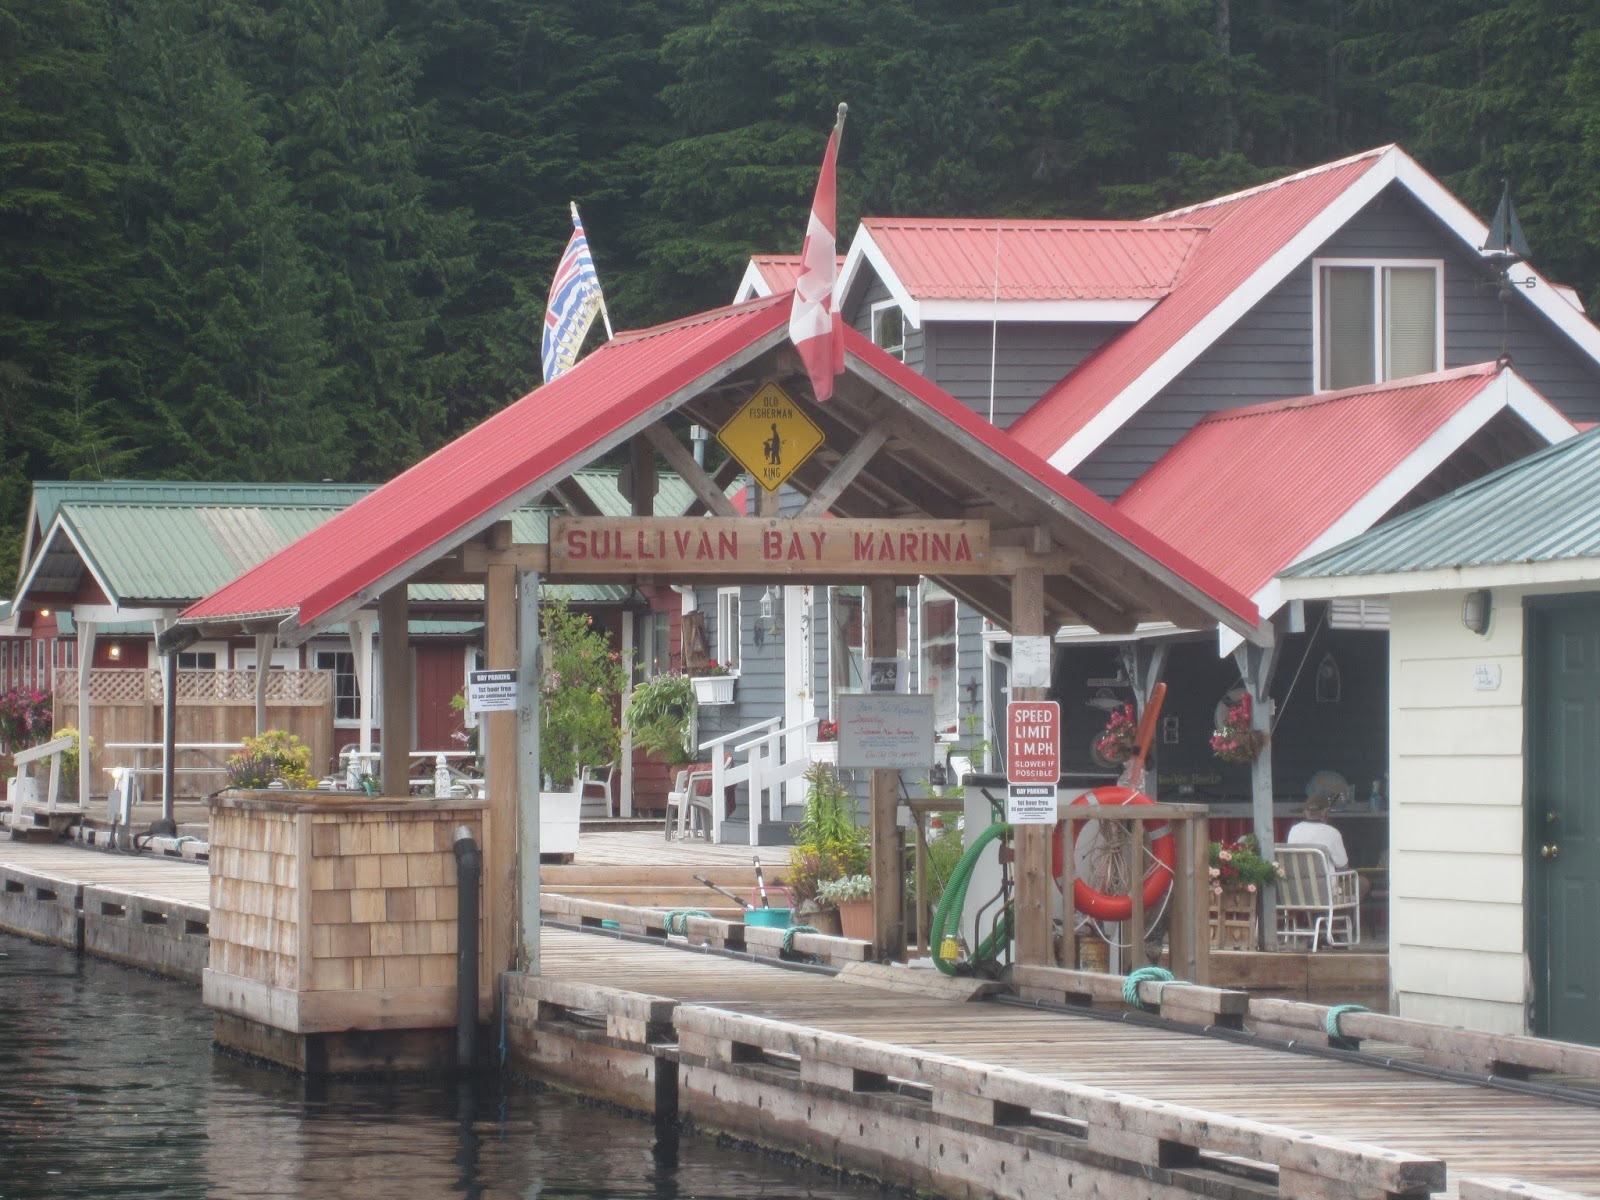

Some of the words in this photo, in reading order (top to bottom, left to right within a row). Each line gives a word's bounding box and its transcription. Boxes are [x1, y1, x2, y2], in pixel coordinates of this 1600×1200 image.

[763, 396, 779, 407] OLD
[750, 408, 793, 419] FISHERMAN
[763, 467, 781, 478] XING
[567, 530, 738, 560] SULLIVAN
[763, 531, 827, 561] BAY
[853, 531, 973, 562] MARINA
[1014, 709, 1052, 723] SPEED
[1015, 725, 1052, 739] LIMIT
[1015, 742, 1019, 755] 1
[1024, 742, 1055, 755] M.P.H.
[1015, 760, 1046, 768] SLOWER
[1015, 769, 1053, 777] POSSIBLE
